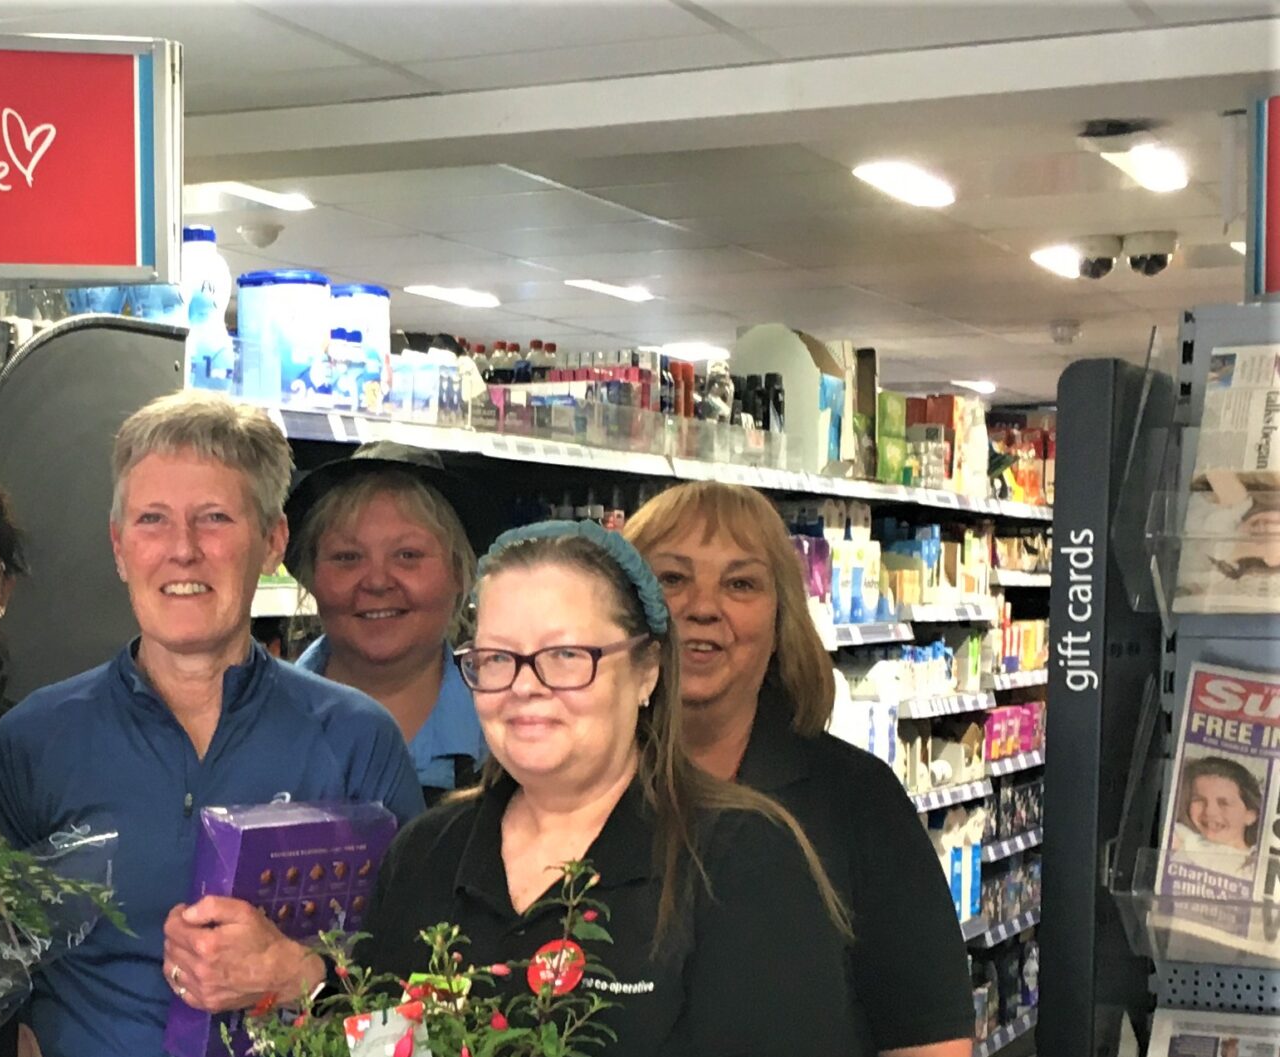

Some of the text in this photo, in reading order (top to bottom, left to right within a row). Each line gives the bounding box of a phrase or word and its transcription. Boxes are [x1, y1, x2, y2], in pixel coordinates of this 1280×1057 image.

[1057, 528, 1099, 692] gift cards
[1191, 713, 1252, 746] FREE
[1167, 862, 1250, 897] Charlotte's
[594, 979, 655, 995] co-operative
